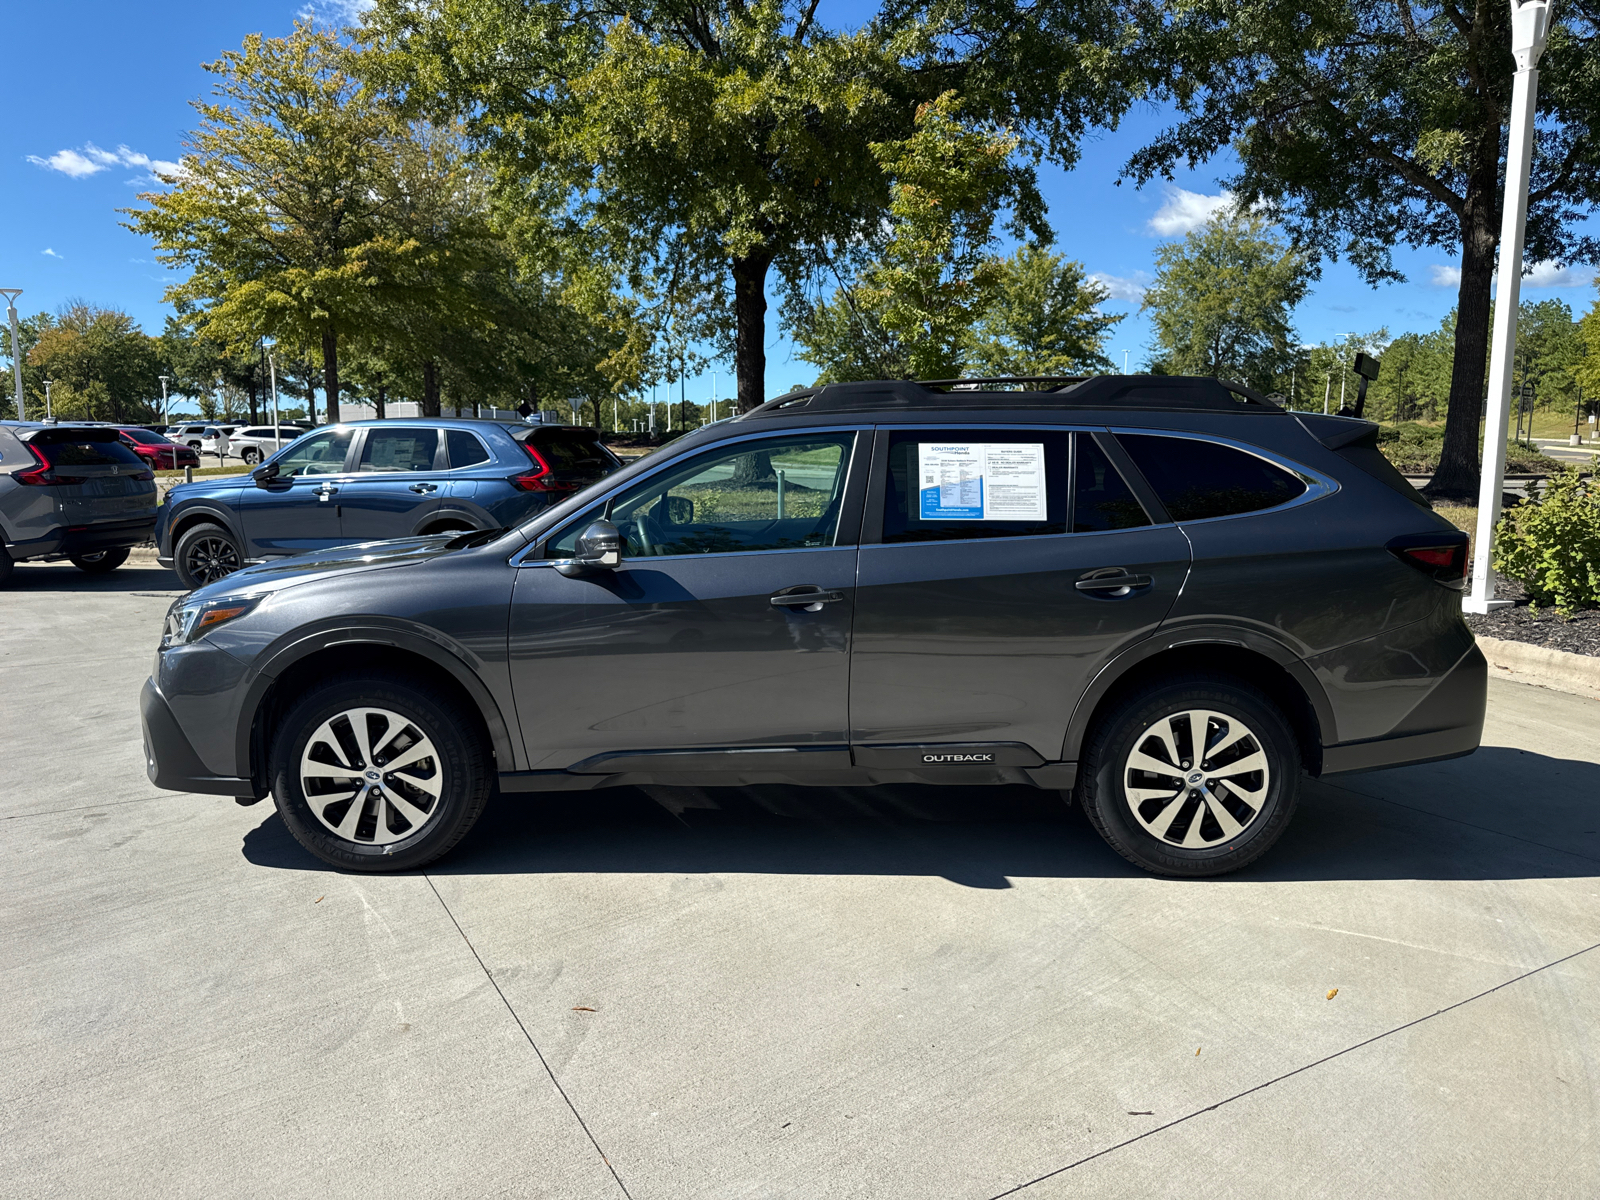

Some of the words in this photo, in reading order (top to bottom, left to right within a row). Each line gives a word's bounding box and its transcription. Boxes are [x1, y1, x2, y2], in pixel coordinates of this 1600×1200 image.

[374, 689, 442, 730] ADVANTA
[445, 741, 462, 793] HTR-800
[1112, 698, 1168, 753] ADVANTA
[1181, 690, 1238, 705] HTR-800
[1228, 807, 1284, 861] ADVANTA
